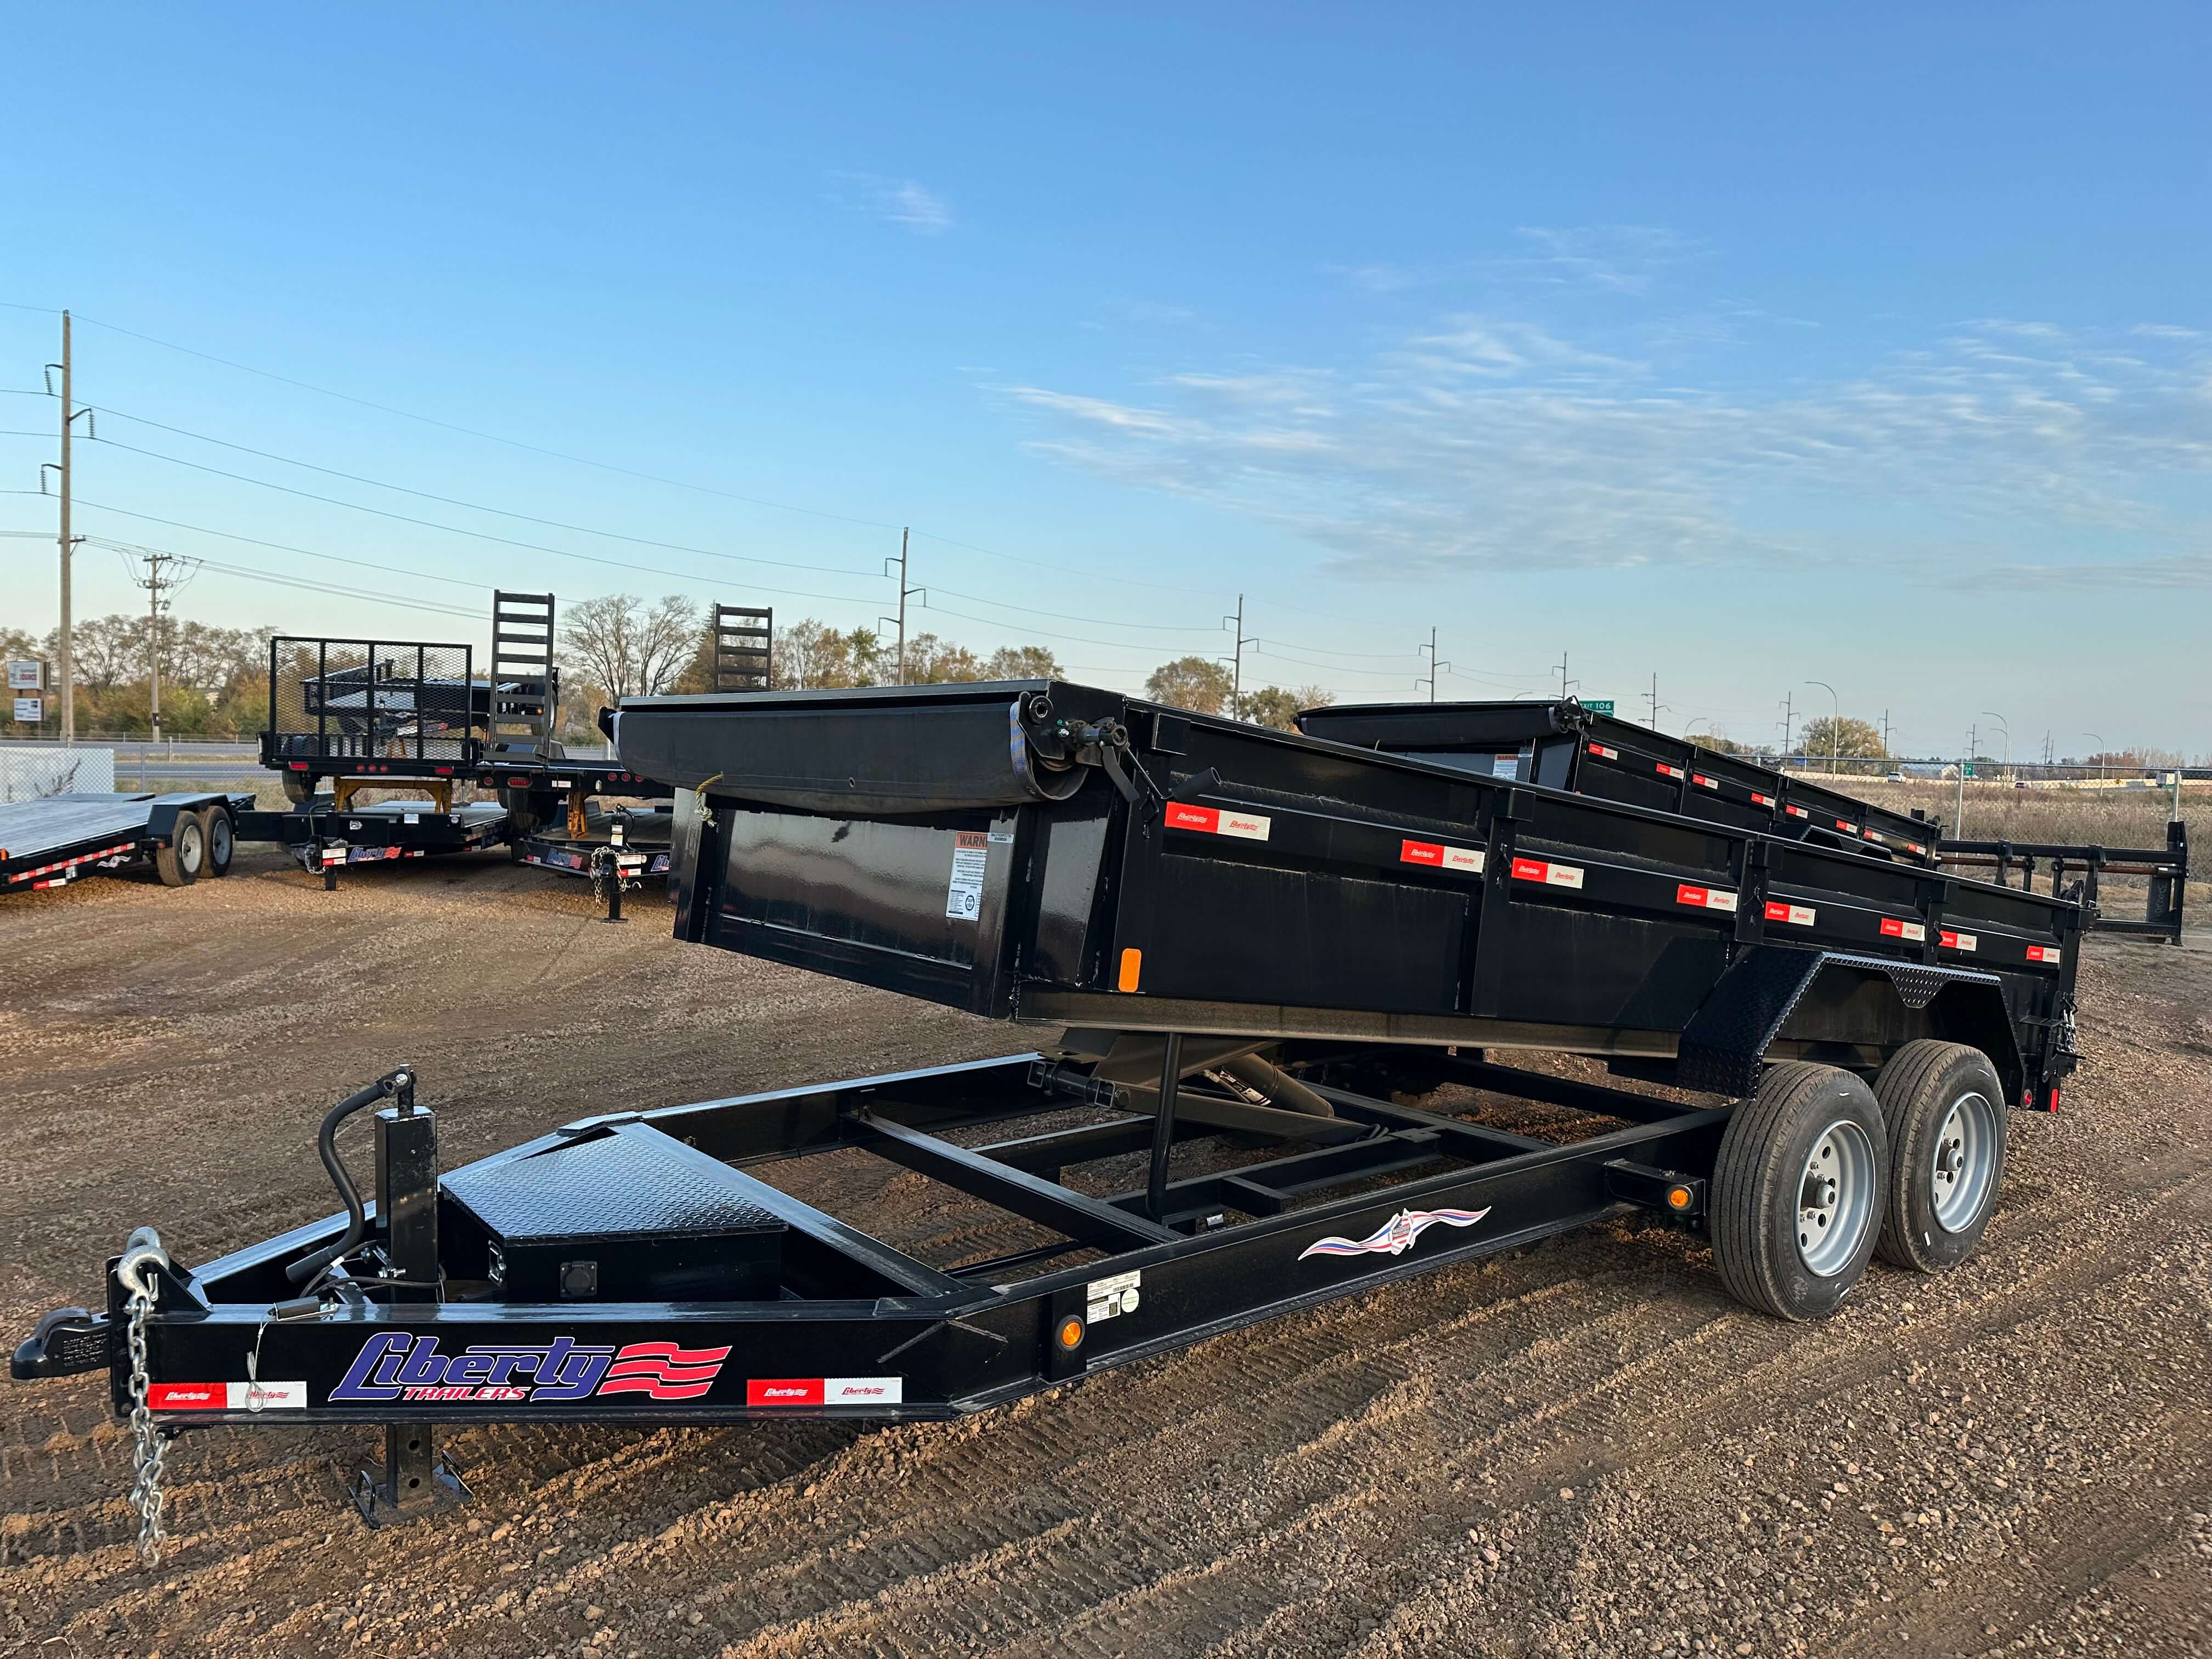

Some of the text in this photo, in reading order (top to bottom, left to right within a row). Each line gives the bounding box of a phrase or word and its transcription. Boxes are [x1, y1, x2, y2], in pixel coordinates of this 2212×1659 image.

[328, 1332, 614, 1402] Liberty
[402, 1386, 531, 1401] TRAILERS
[764, 1388, 796, 1397] Liberty
[842, 1387, 873, 1396] Liberty
[165, 1392, 196, 1401] Liberty
